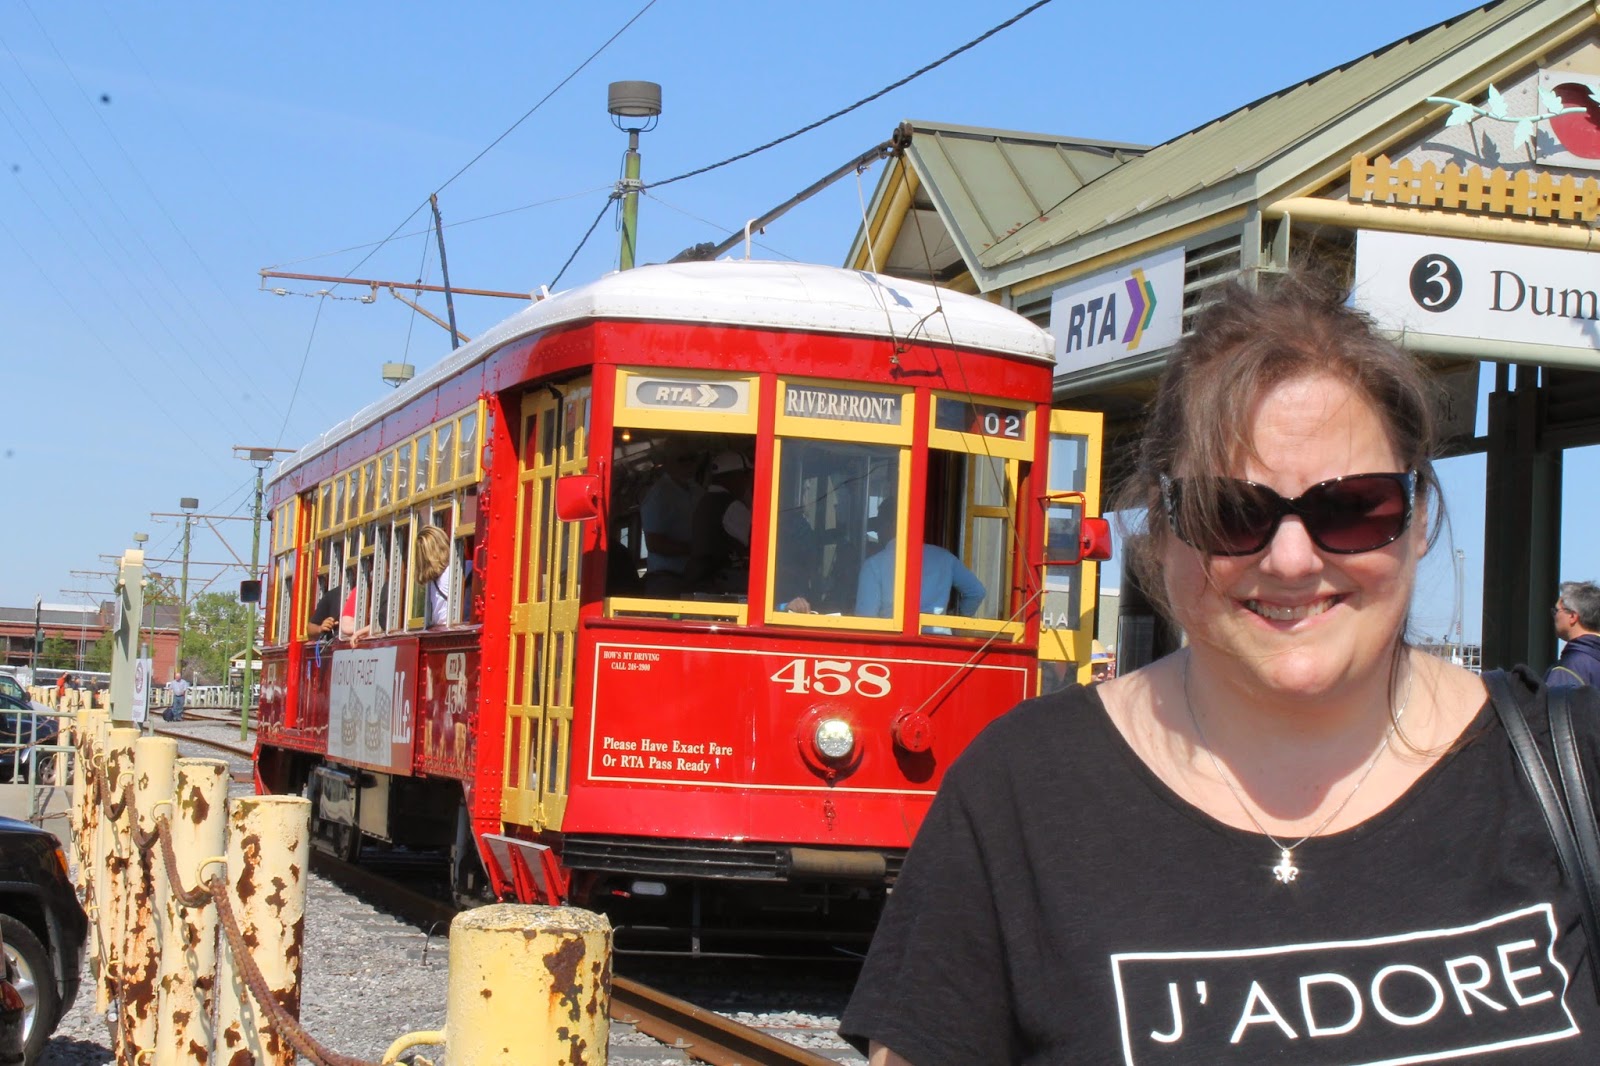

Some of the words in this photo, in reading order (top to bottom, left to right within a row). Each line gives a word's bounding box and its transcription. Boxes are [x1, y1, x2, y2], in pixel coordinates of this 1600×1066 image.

[1422, 259, 1451, 308] 3
[1489, 270, 1600, 321] Dum
[1066, 293, 1117, 354] RTA
[655, 386, 693, 403] RTA
[786, 389, 896, 420] RIVERFRONT
[984, 412, 1020, 438] 02
[603, 650, 622, 660] HOW'S
[622, 651, 633, 661] MY
[633, 652, 660, 662] DRIVING
[611, 661, 627, 671] CALL
[770, 659, 892, 698] 458
[603, 736, 637, 751] Please
[641, 738, 668, 753] Have
[672, 740, 705, 755] Exact
[708, 742, 733, 756] Fare
[602, 753, 617, 767] Or
[620, 755, 645, 769] RTA
[648, 756, 673, 771] Pass
[676, 757, 711, 775] Ready
[1150, 939, 1555, 1044] J'ADORE
